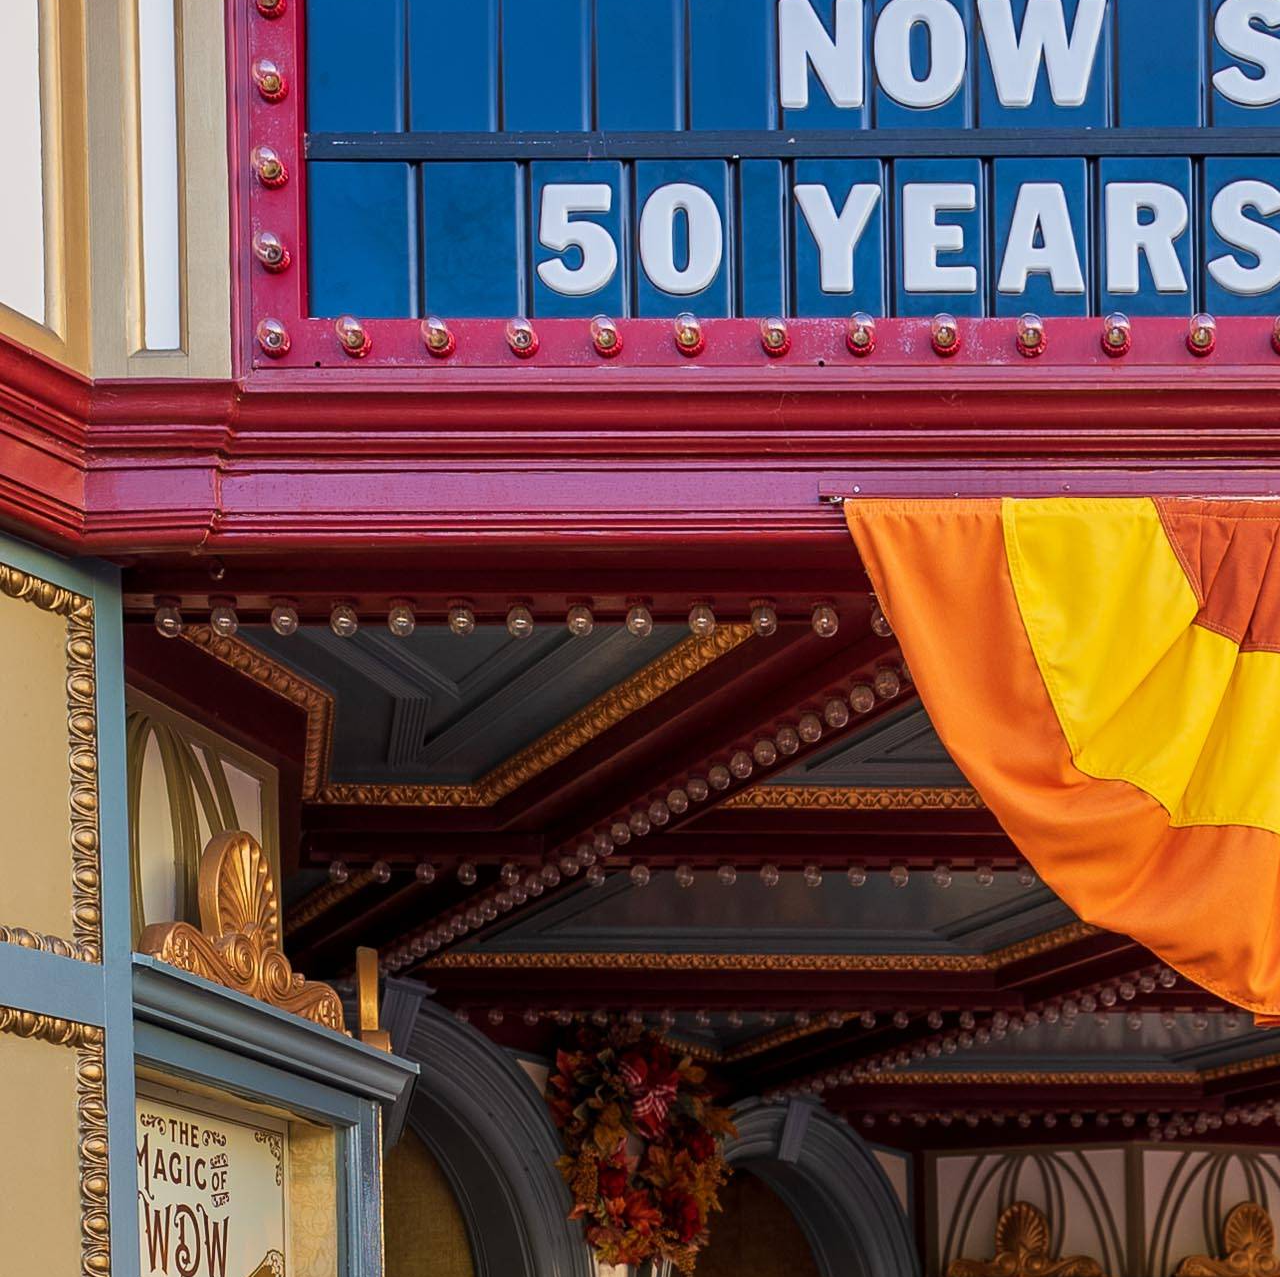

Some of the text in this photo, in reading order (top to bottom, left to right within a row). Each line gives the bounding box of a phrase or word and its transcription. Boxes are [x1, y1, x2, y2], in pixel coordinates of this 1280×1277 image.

[536, 182, 723, 296] 50
[168, 1120, 200, 1149] THE
[211, 1170, 228, 1192] OF
